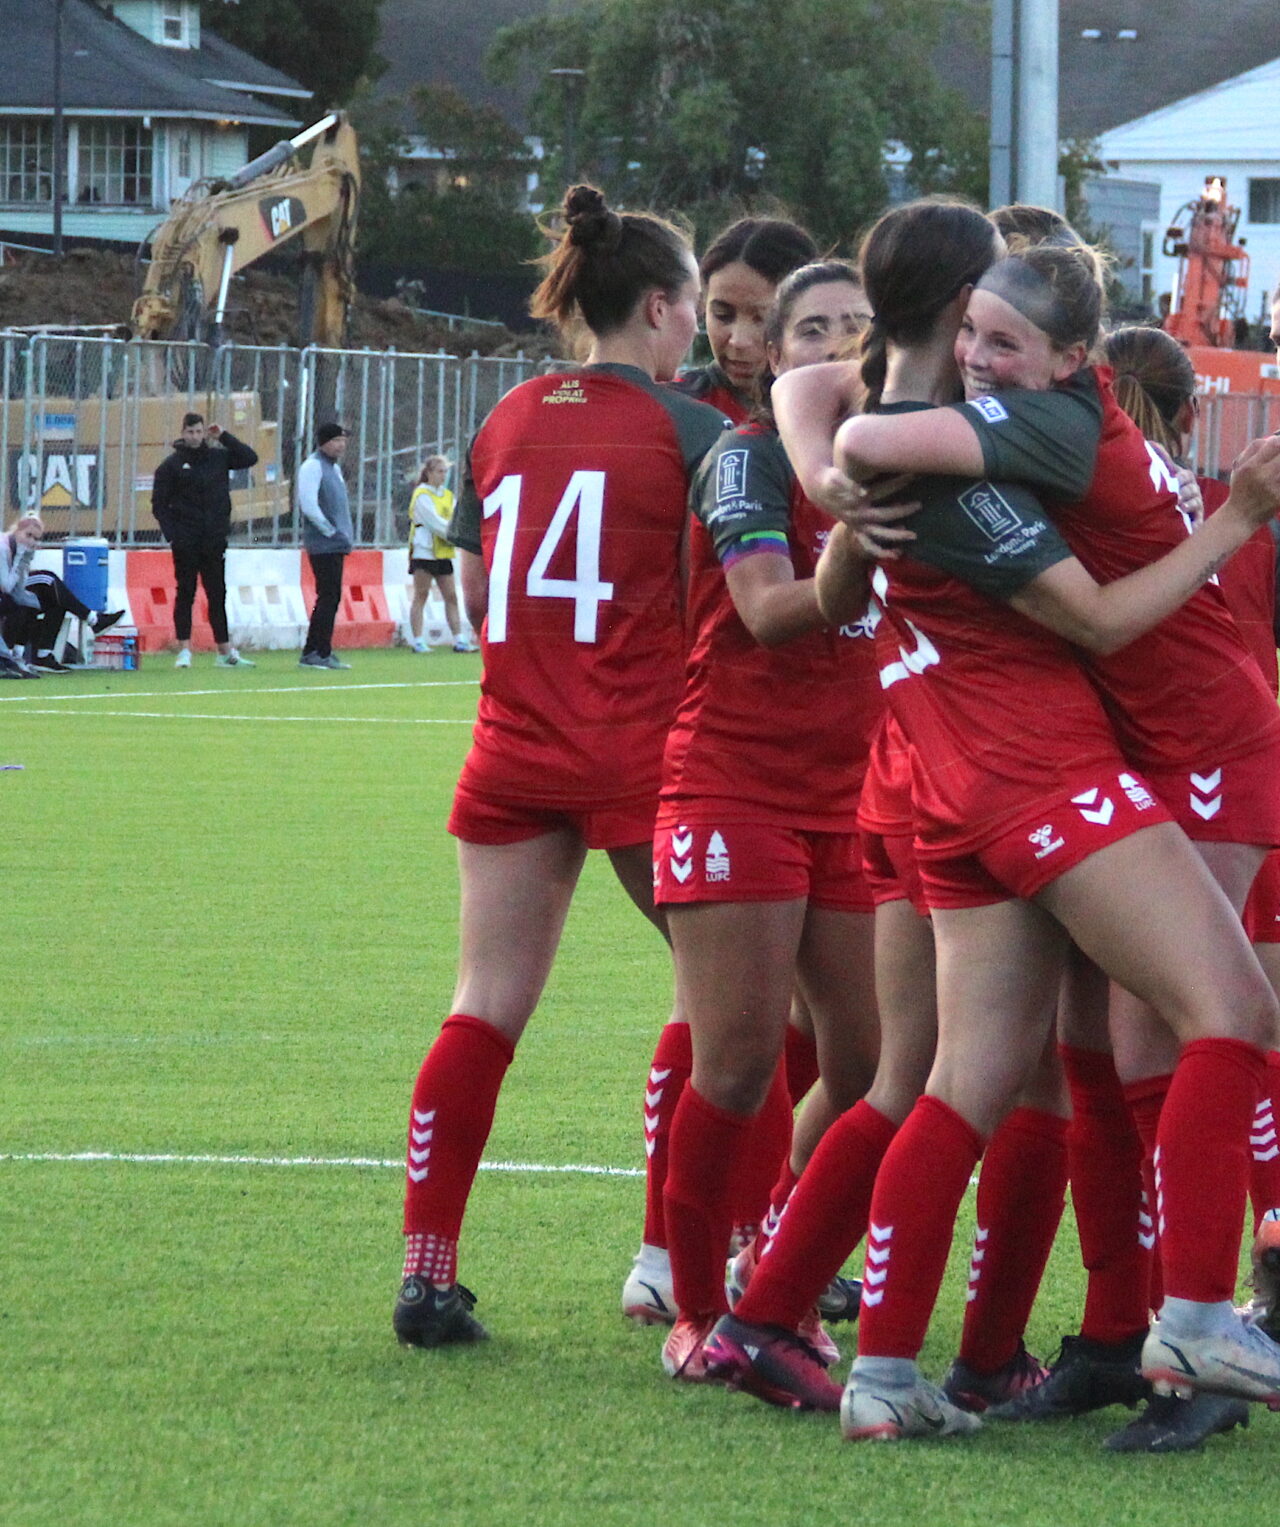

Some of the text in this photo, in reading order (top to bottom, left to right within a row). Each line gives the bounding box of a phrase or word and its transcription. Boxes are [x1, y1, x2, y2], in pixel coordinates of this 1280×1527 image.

[270, 198, 292, 237] CAT
[17, 453, 98, 507] CAT
[482, 470, 614, 643] 14
[705, 873, 730, 882] LUFC
